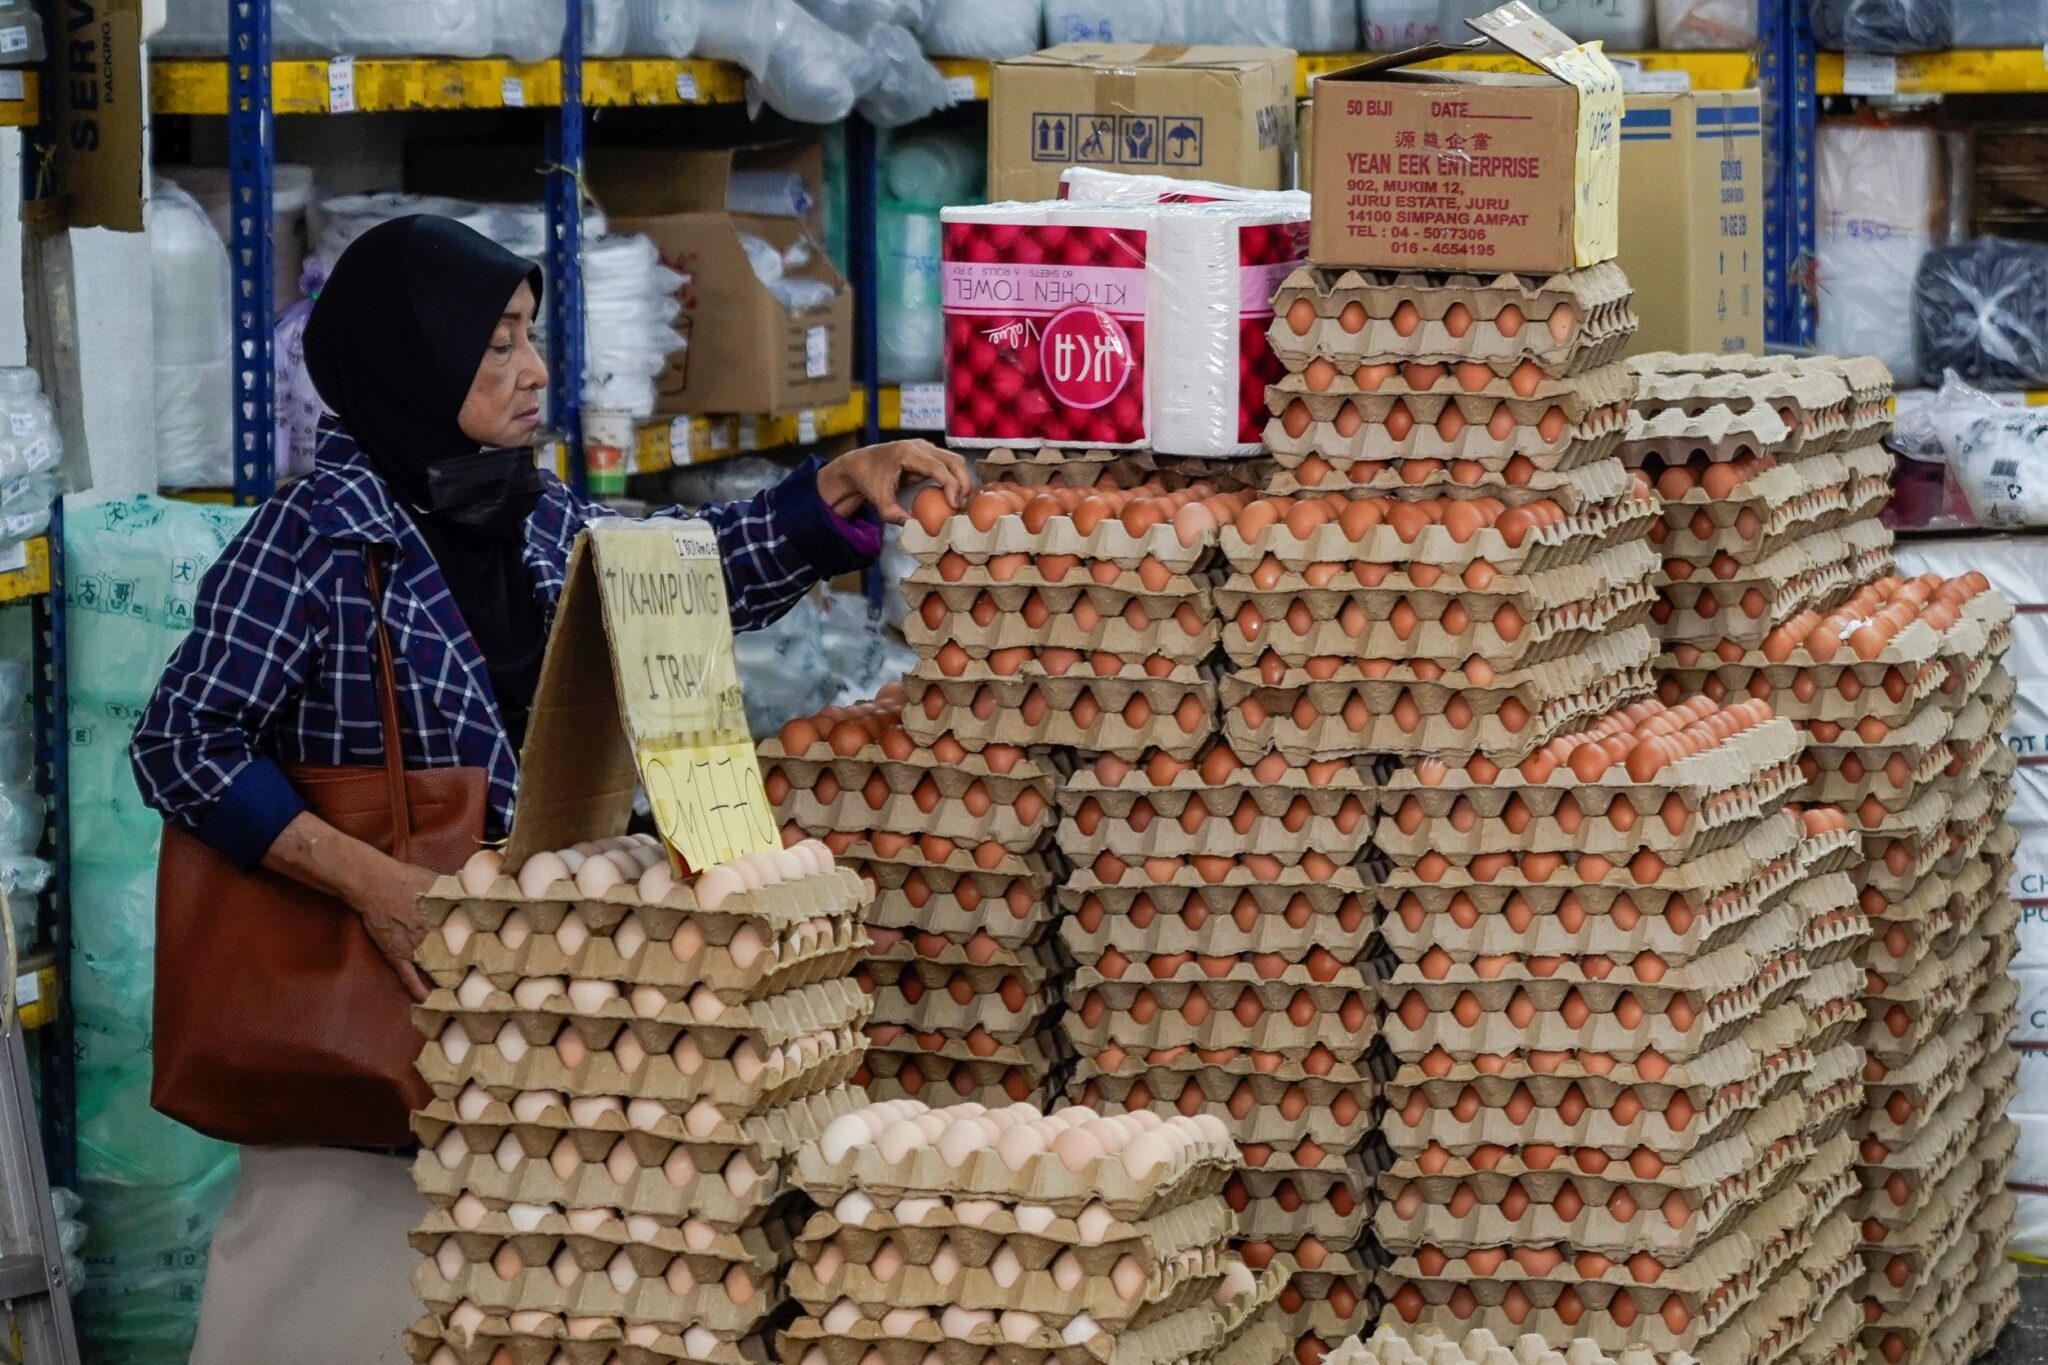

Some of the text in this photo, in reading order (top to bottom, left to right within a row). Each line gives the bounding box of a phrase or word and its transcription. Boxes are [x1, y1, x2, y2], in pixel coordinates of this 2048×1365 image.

[101, 22, 114, 104] PACKING
[1347, 100, 1469, 118] 50 BIJI DATE
[1347, 153, 1540, 179] YEAN EEK ENTERPRISE
[1347, 180, 1465, 196] 902, MUKIM 12,
[1347, 195, 1509, 211] JURU ESTATE, JURU
[1347, 210, 1530, 227] 14100 SIMPANG AMPAT
[1347, 225, 1377, 238] TEL
[1391, 226, 1410, 239] 04
[1423, 227, 1486, 241] 5077306
[1391, 241, 1418, 254] 016
[1432, 243, 1496, 257] 4554195
[982, 267, 1010, 277] ROLLS
[1029, 268, 1060, 278] SHEETS
[1062, 270, 1073, 278] 60
[953, 278, 1127, 305] KITCHEN TOWEL
[988, 317, 1040, 348] Value
